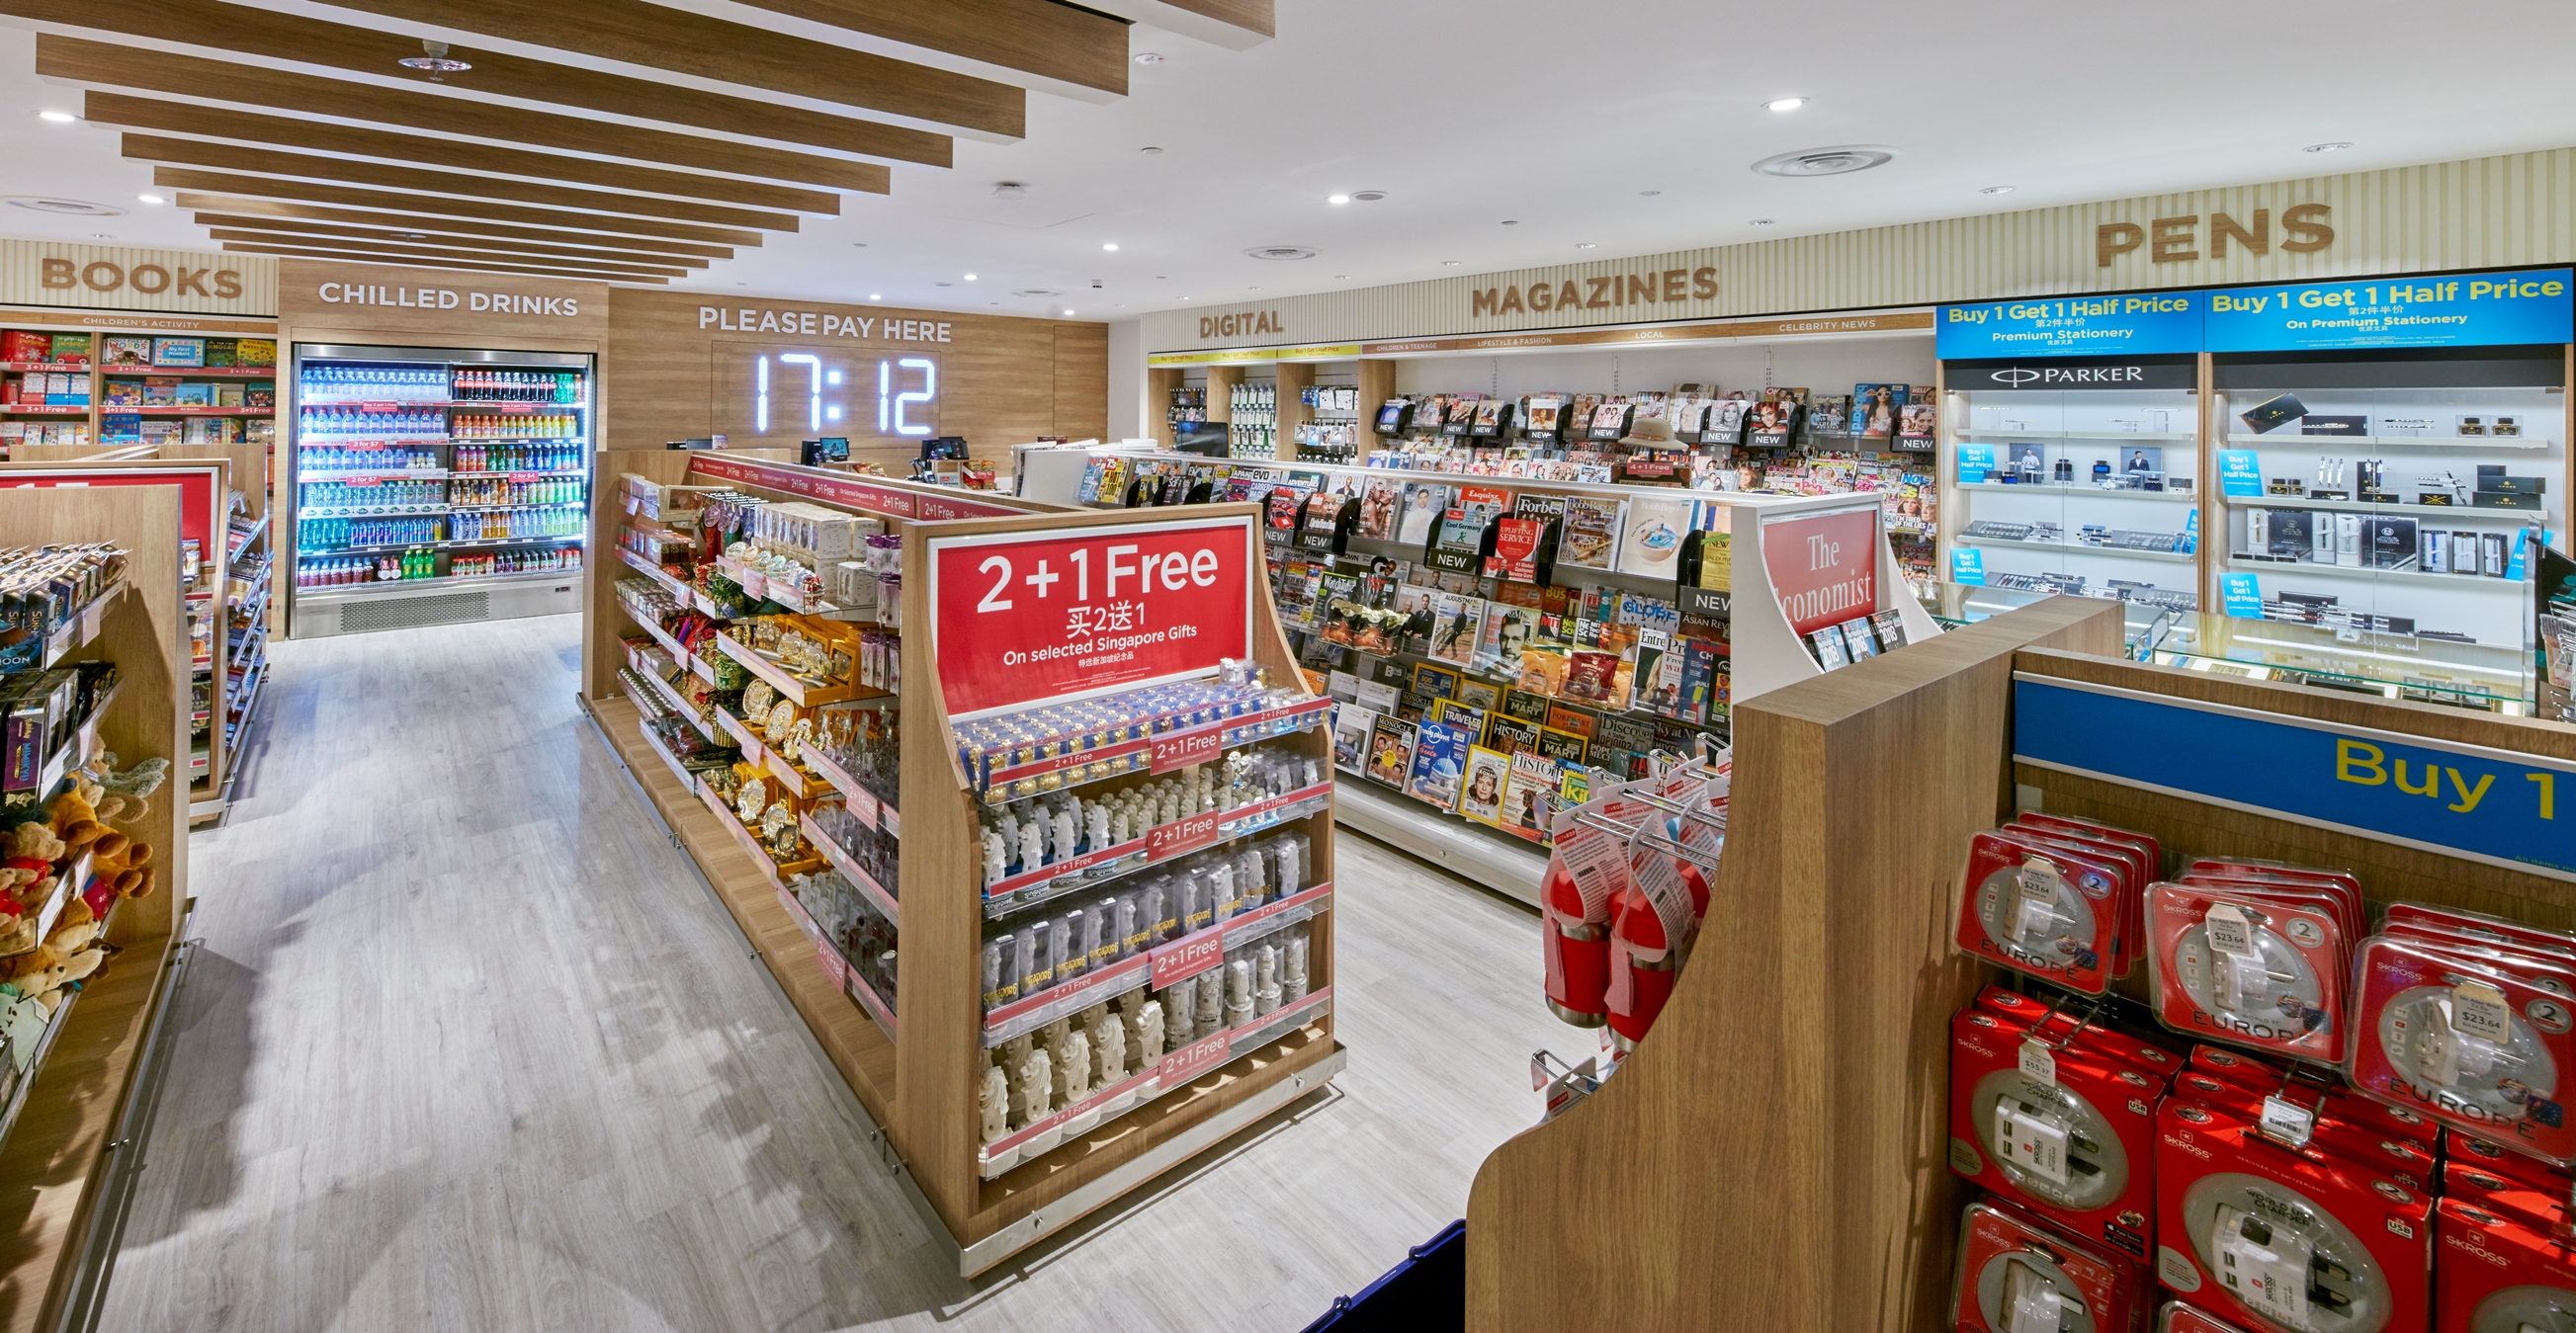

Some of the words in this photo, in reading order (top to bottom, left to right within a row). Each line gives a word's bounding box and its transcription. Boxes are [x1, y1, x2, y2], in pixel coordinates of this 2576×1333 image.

[2098, 203, 2334, 268] PENS
[42, 258, 243, 298] BOOKS
[318, 282, 460, 311] CHILLED
[470, 292, 579, 317] DRINKS
[1472, 266, 1718, 318] MAGAZINES
[2212, 295, 2269, 313] Buy
[2276, 292, 2288, 309] 1
[2298, 290, 2355, 308] Get
[2365, 287, 2377, 305] 1
[2389, 283, 2459, 304] Half
[2469, 279, 2564, 300] Price
[1948, 307, 1989, 324] Buy
[1994, 305, 2003, 321] 1
[2009, 303, 2049, 320] Get
[2055, 301, 2064, 317] 1
[2071, 299, 2118, 317] Half
[2125, 297, 2190, 314] Price
[83, 317, 147, 327] CHILDREN'S
[151, 320, 200, 329] ACTIVITY
[699, 306, 816, 335] PLEASE
[822, 315, 875, 338] PAY
[883, 319, 952, 343] HERE
[1199, 310, 1284, 339] DIGITAL
[1778, 321, 1835, 333] CELEBRITY
[1837, 319, 1876, 330] NEWS
[2286, 320, 2307, 329] On
[2311, 317, 2379, 328] Premium
[2384, 313, 2468, 327] Stationery
[1992, 329, 2053, 342] Premium
[2057, 327, 2133, 340] Stationery
[2044, 366, 2143, 382] PARKER
[1851, 384, 1867, 431] billboard
[1253, 469, 1269, 480] evo
[815, 482, 823, 495] 2+1
[823, 485, 835, 497] Free
[1468, 489, 1500, 501] Esquire
[883, 495, 894, 508] 2+1
[895, 497, 909, 512] Free
[924, 502, 937, 516] 2+1
[938, 505, 955, 520] Free
[1519, 498, 1563, 516] Forbes
[1569, 498, 1590, 510] Robb
[1590, 500, 1617, 512] Report
[1641, 501, 1660, 511] Robb
[1660, 502, 1683, 513] Report
[1446, 520, 1458, 529] Cool
[1459, 521, 1482, 533] Germany
[1501, 526, 1534, 537] UPLIFTING
[1265, 531, 1287, 542] NEW
[1304, 536, 1328, 547] NEW
[1499, 534, 1533, 545] SERVICE
[1437, 554, 1467, 569] NEW
[1807, 533, 1840, 572] The
[1107, 544, 1218, 599] Free
[1775, 569, 1872, 625] conomist
[1622, 600, 1677, 621] GLOBE
[1067, 601, 1146, 639] 买2送1
[1541, 616, 1561, 628] MIT
[1682, 615, 1709, 627] ASIAN
[1879, 625, 1898, 645] 2018
[1003, 648, 1027, 667] On
[1031, 639, 1093, 663] selected
[1096, 629, 1165, 658] Singapore
[1168, 625, 1197, 642] Gifts
[1848, 635, 1868, 655] 2018
[0, 656, 31, 666] OON
[1581, 662, 1604, 673] NOUGAT
[1402, 692, 1432, 708] MONOCLE
[1510, 702, 1541, 716] MARY
[1379, 717, 1413, 734] MONOCLE
[1445, 709, 1482, 726] TRAVELER
[1431, 731, 1450, 743] planet
[1494, 722, 1536, 744] HISTORY
[1603, 718, 1654, 740] Discover
[1188, 733, 1217, 753] Free
[1074, 753, 1093, 764] Free
[2336, 737, 2496, 813] Buy
[2526, 772, 2554, 820] 1
[1184, 818, 1213, 838] Free
[1074, 857, 1092, 869] Free
[1978, 848, 2011, 864] SKROSS
[2515, 854, 2529, 864] All
[2532, 856, 2559, 869] items
[2023, 880, 2049, 894] $23.64
[2163, 903, 2202, 917] SKROSS
[2214, 931, 2245, 945] $23.64
[1187, 939, 1218, 961] Free
[1980, 938, 2080, 982] EUROPE
[2376, 960, 2424, 982] SKROSS
[2461, 1011, 2501, 1030] $23.64
[2193, 1010, 2316, 1050] EUROPE
[1195, 1037, 1225, 1060] Free
[1957, 1037, 1994, 1058] SKROSS
[2024, 1059, 2050, 1075] $55.37
[2389, 1077, 2539, 1141] EUROPE
[2164, 1133, 2211, 1159] SKROSS
[2236, 1155, 2270, 1172] DESIGNED
[2280, 1173, 2327, 1194] SWITZERLAND
[2246, 1188, 2288, 1211] WORLD
[2291, 1208, 2316, 1223] USB
[2254, 1199, 2310, 1228] CHARGER
[2389, 1220, 2412, 1235] USB
[2446, 1233, 2509, 1267] SKROSS
